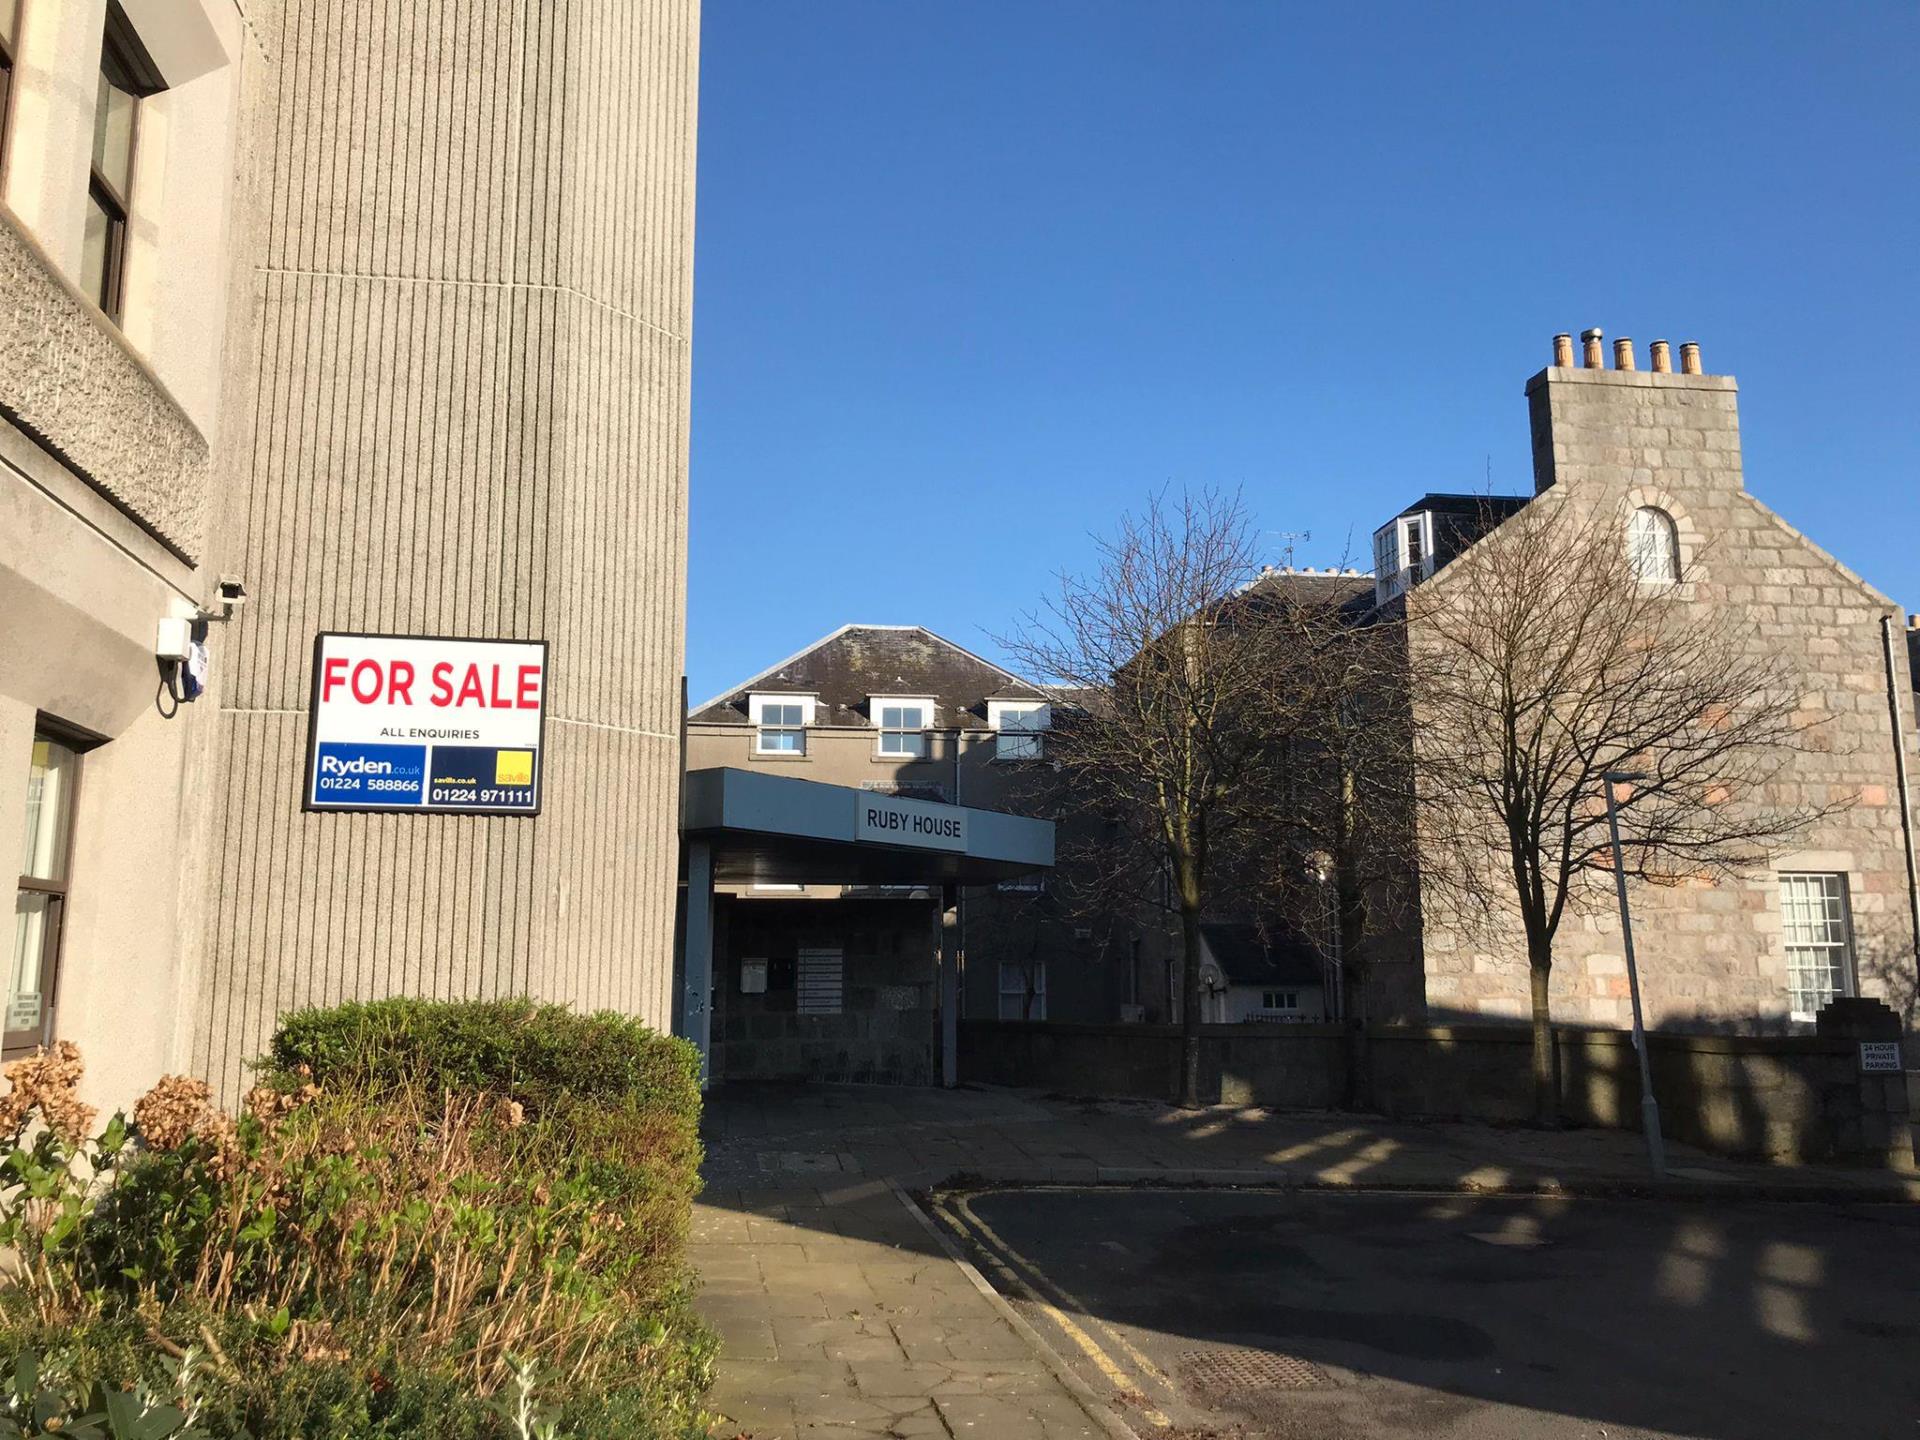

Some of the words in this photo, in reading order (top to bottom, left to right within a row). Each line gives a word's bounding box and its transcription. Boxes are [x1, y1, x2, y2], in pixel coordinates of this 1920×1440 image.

[323, 658, 415, 706] FOR
[430, 661, 541, 709] SALE
[380, 727, 405, 738] ALL
[409, 728, 480, 740] ENQUIRIES
[321, 755, 420, 777] Ryden.co.uk
[320, 778, 360, 790] 01224
[367, 779, 419, 792] 588866
[432, 788, 477, 802] 01224
[480, 789, 532, 803] 971111
[867, 808, 909, 831] RUBY
[913, 815, 961, 838] HOUSE
